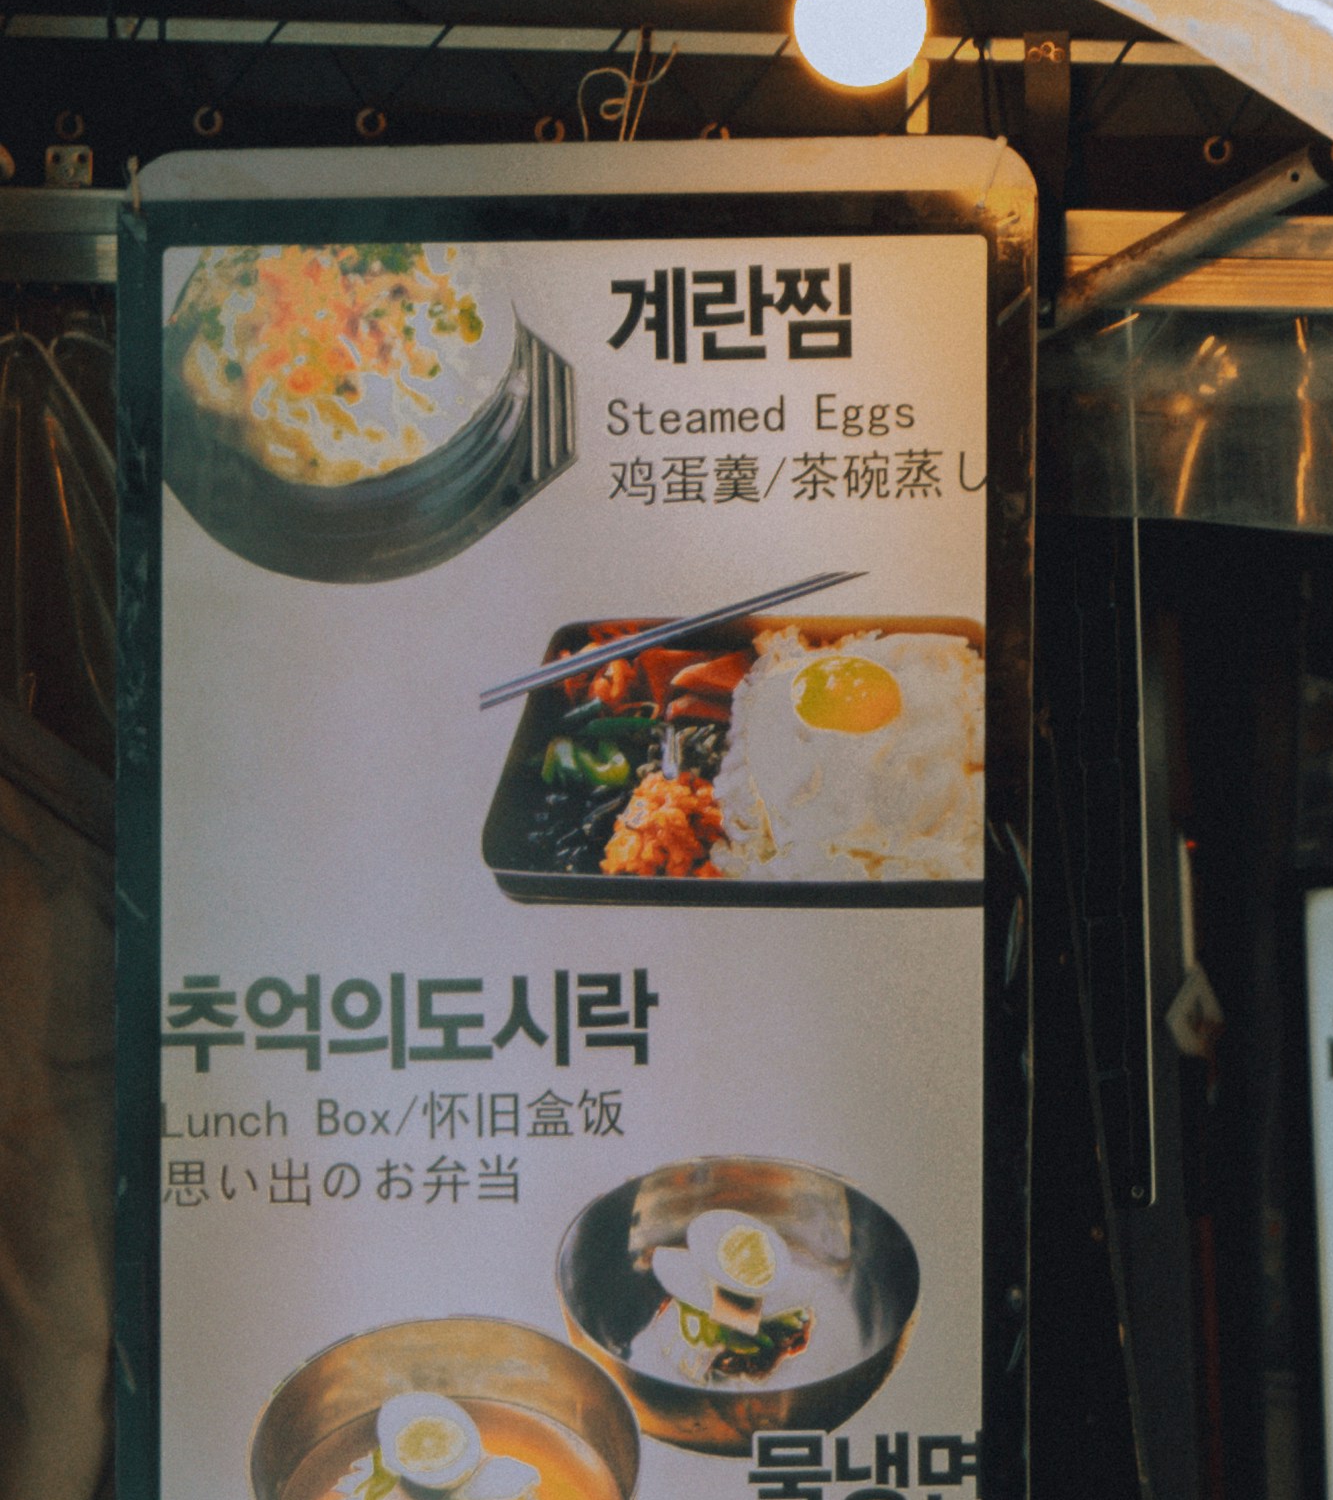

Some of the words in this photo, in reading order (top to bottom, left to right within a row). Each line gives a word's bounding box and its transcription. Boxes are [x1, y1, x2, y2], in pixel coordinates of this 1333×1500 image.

[606, 263, 853, 363] 계란찜
[606, 397, 786, 434] Steamed
[816, 394, 915, 434] Eggs
[161, 968, 660, 1073] 추억의도시락
[164, 1155, 521, 1207] 思い出のお弁当
